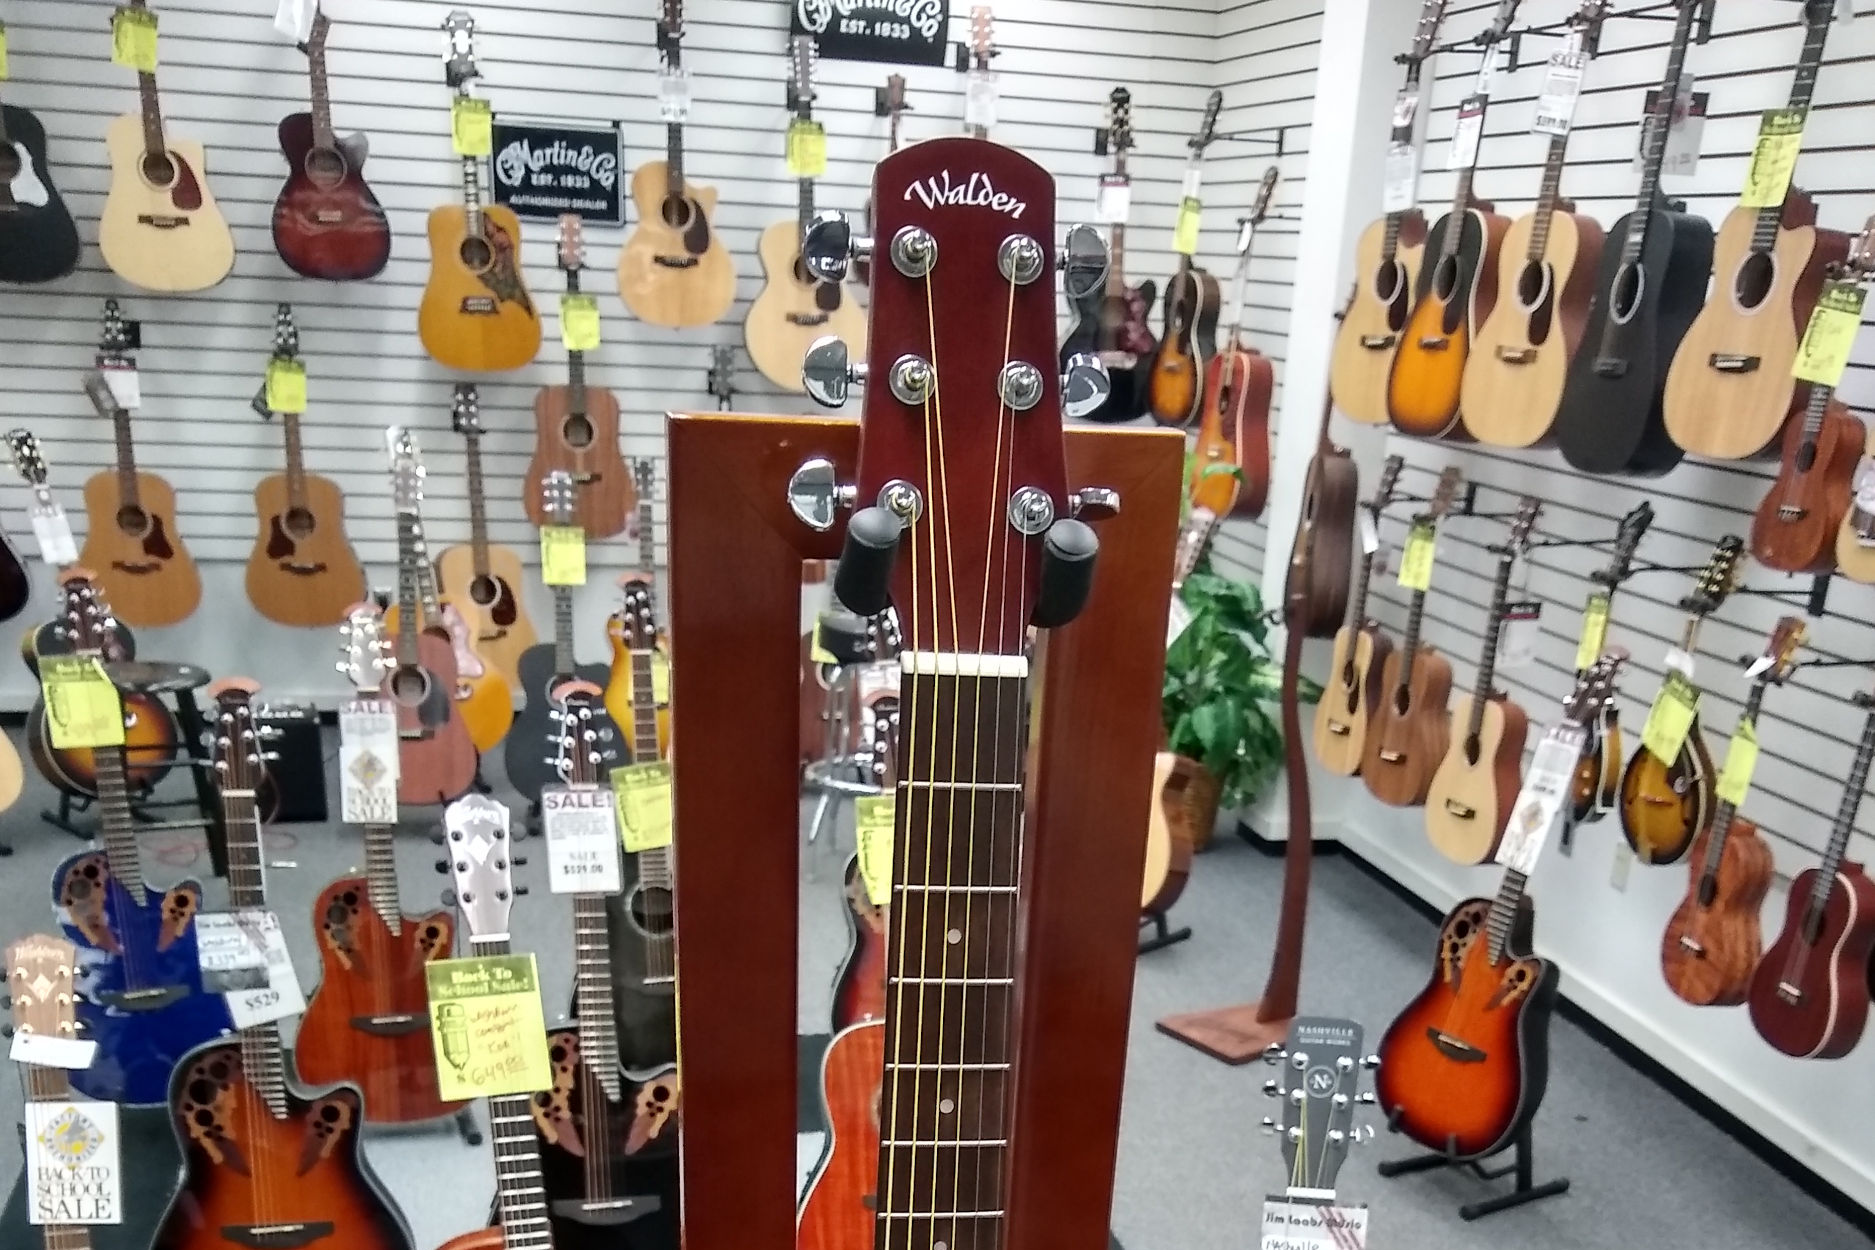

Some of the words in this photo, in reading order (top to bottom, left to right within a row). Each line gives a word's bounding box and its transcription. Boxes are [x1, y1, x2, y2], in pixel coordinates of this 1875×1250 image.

[840, 18, 871, 35] EST.
[904, 169, 1027, 219] Walden
[493, 967, 513, 980] To
[38, 1198, 111, 1219] SALE
[1266, 1212, 1285, 1224] Jim
